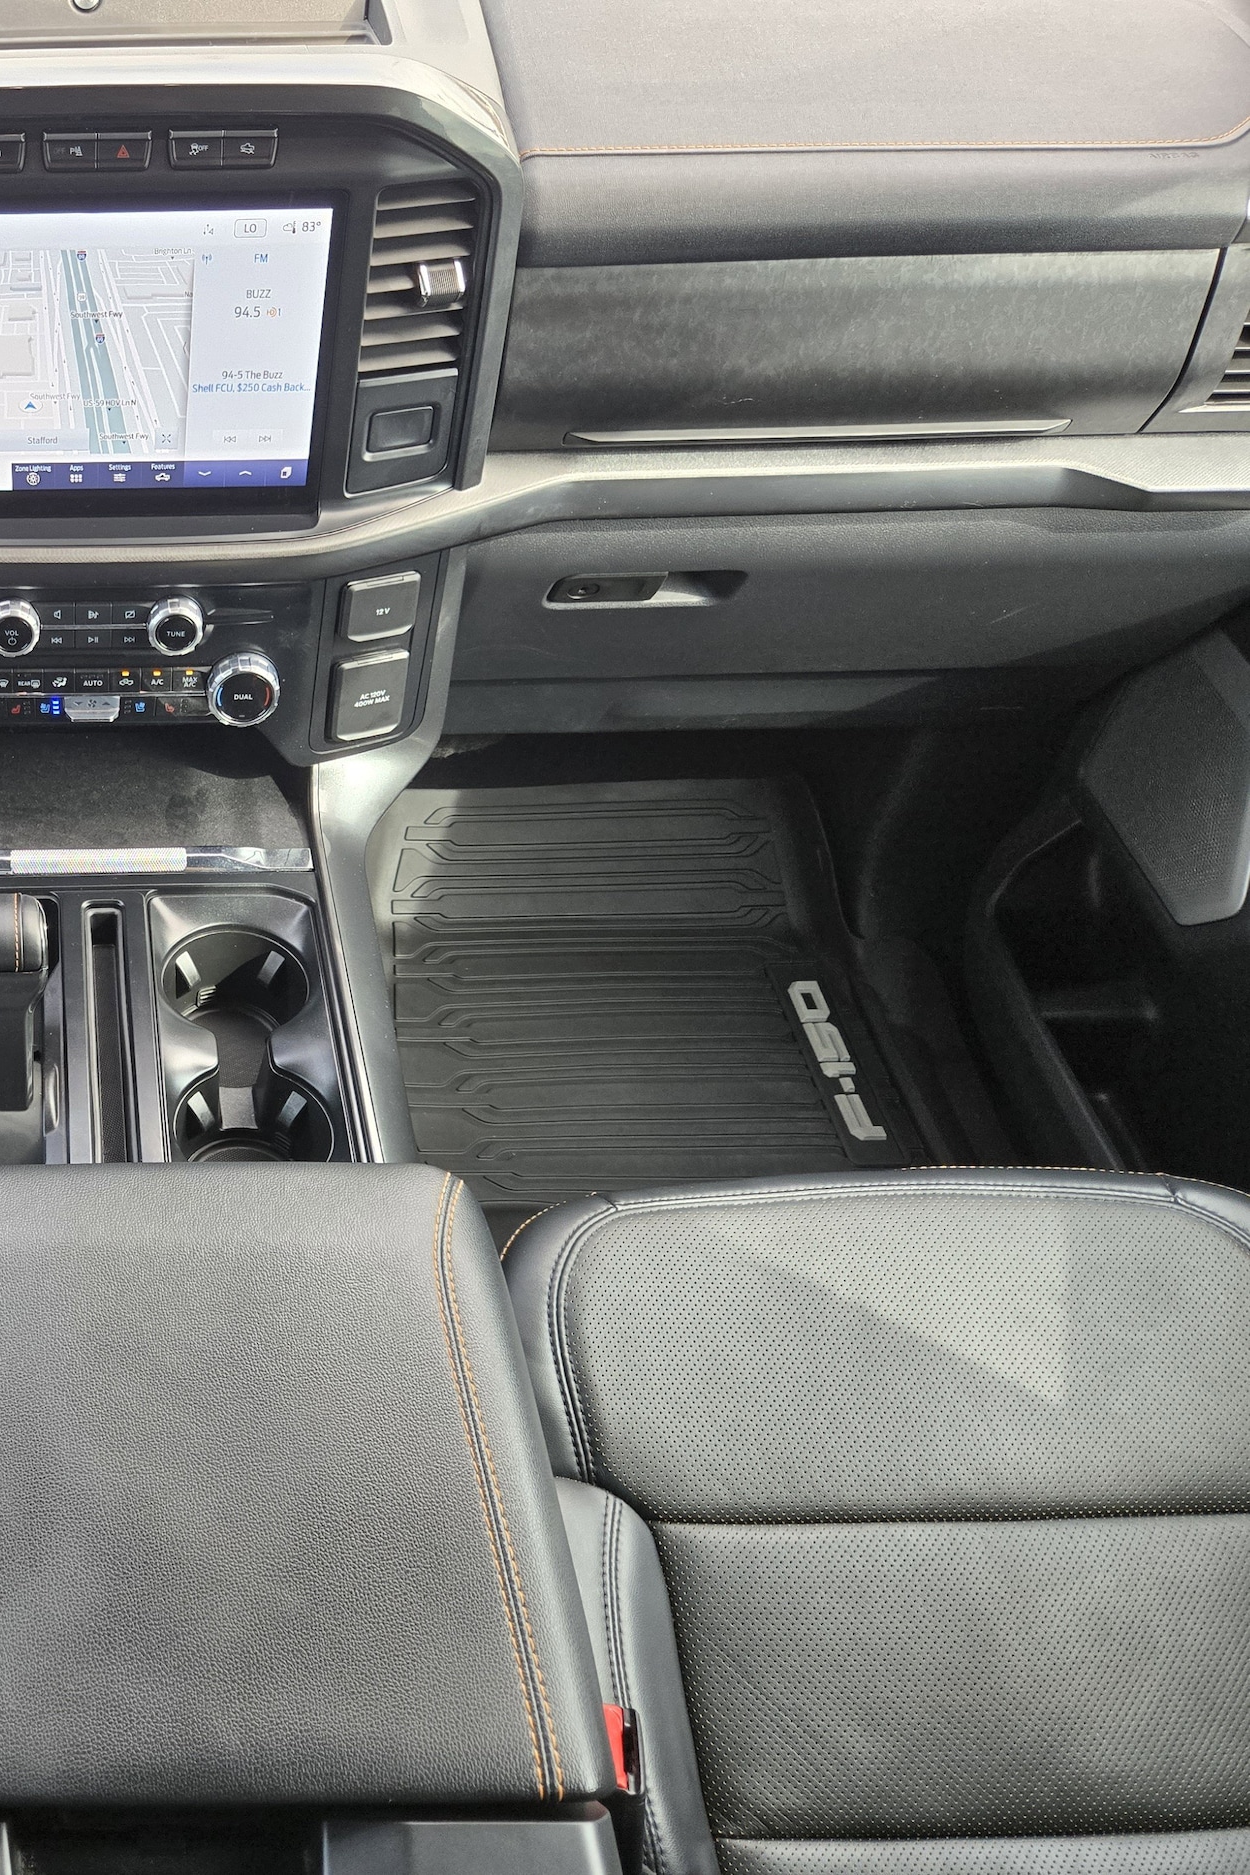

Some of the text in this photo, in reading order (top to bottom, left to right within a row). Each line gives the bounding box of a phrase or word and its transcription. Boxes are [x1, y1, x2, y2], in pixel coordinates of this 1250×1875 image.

[244, 223, 257, 233] LO
[254, 253, 268, 263] FM
[246, 289, 271, 299] BUZZ
[70, 311, 123, 319] Southwest Fwy
[234, 306, 261, 318] 94.5
[222, 370, 283, 379] 94-5 The Buzz
[192, 383, 214, 393] Shell
[237, 383, 260, 392] $250
[261, 383, 282, 392] Cash
[66, 393, 80, 401] Fwy
[83, 399, 104, 407] US-59
[105, 399, 121, 407] HOV
[27, 436, 58, 444] Stafford
[29, 465, 52, 473] Lighting
[108, 464, 131, 472] Settings
[360, 690, 386, 700] AC 120V
[354, 695, 391, 708] 400W MAX
